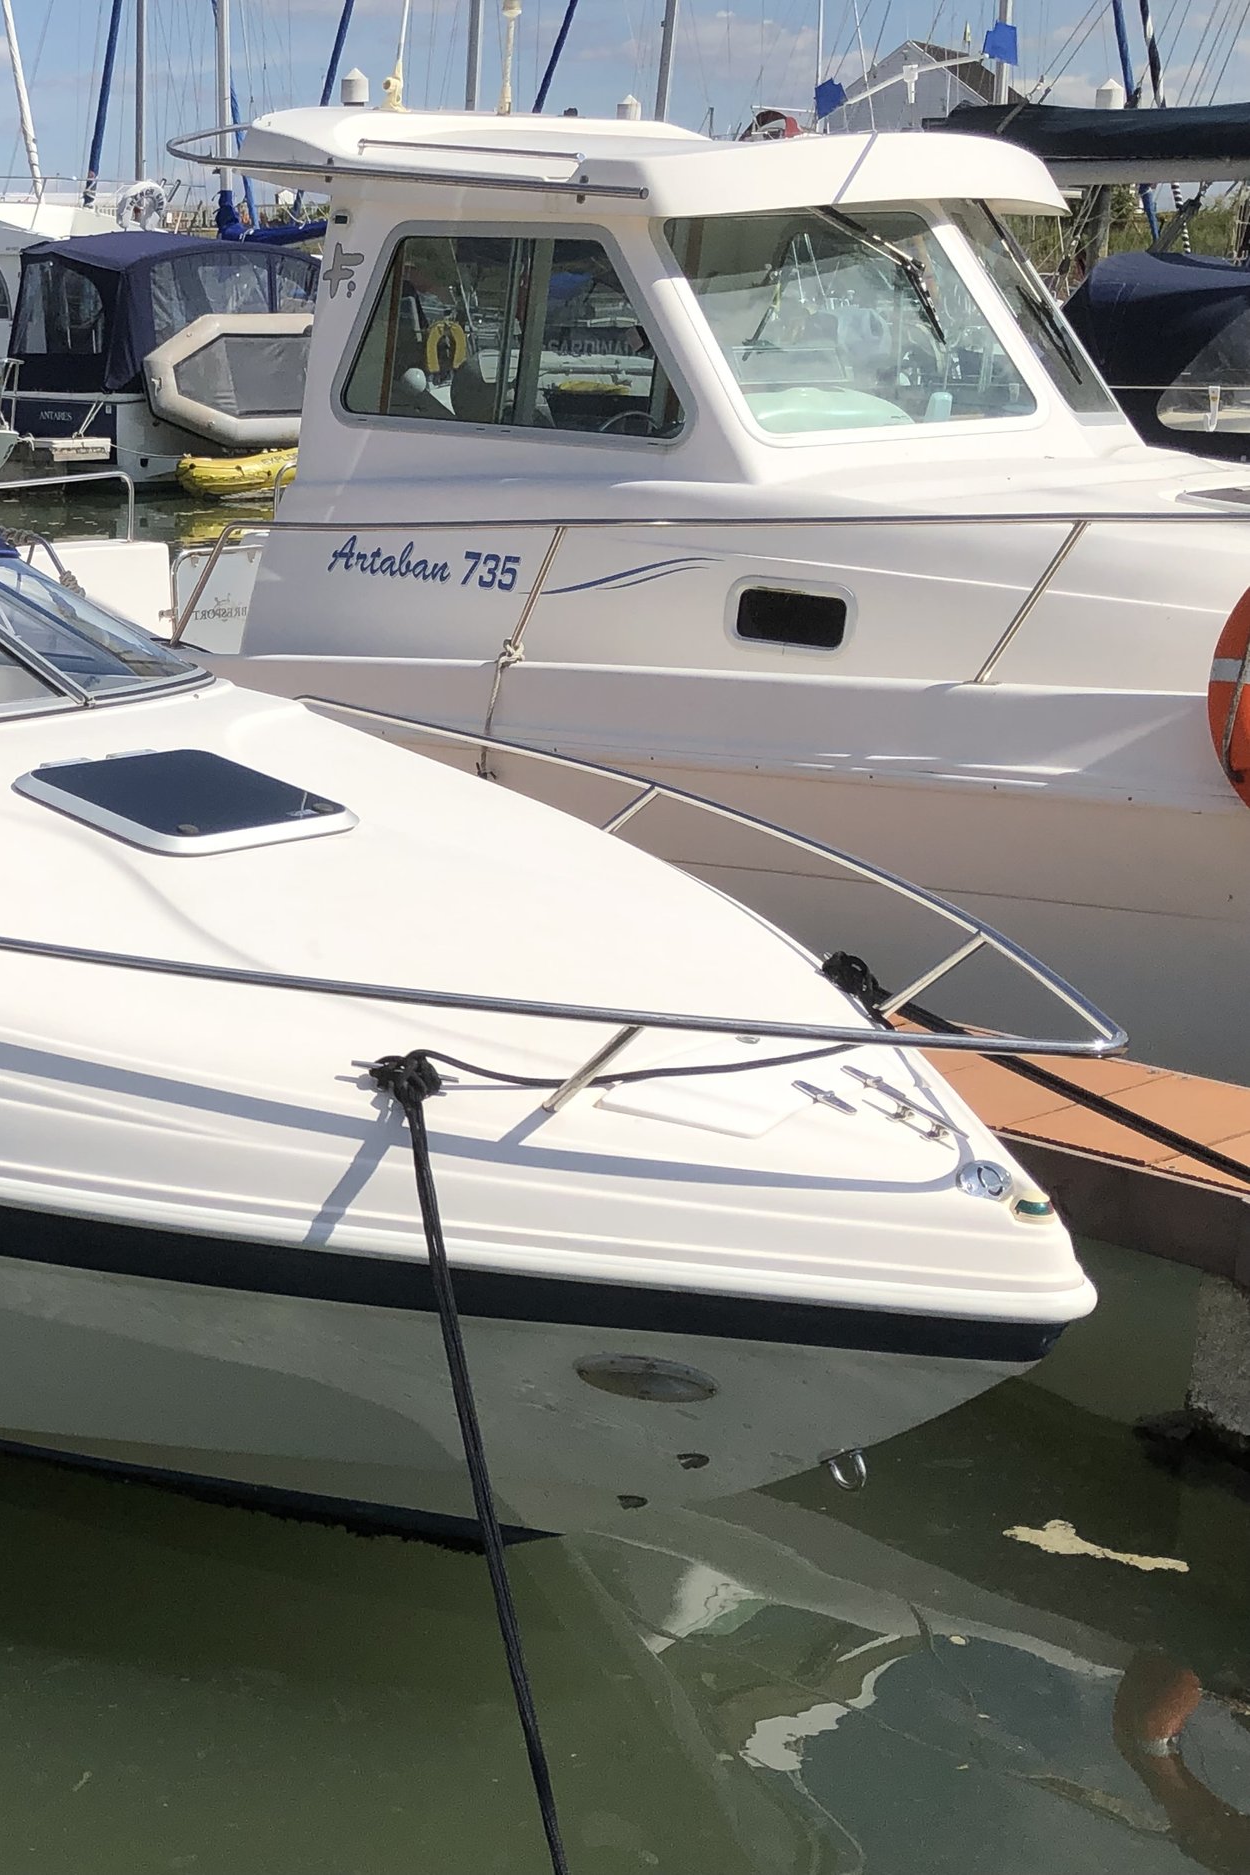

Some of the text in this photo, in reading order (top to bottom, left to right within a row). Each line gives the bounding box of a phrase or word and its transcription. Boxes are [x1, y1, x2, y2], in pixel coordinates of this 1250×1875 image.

[39, 410, 73, 422] ANTARES
[327, 534, 522, 592] Artaban 735
